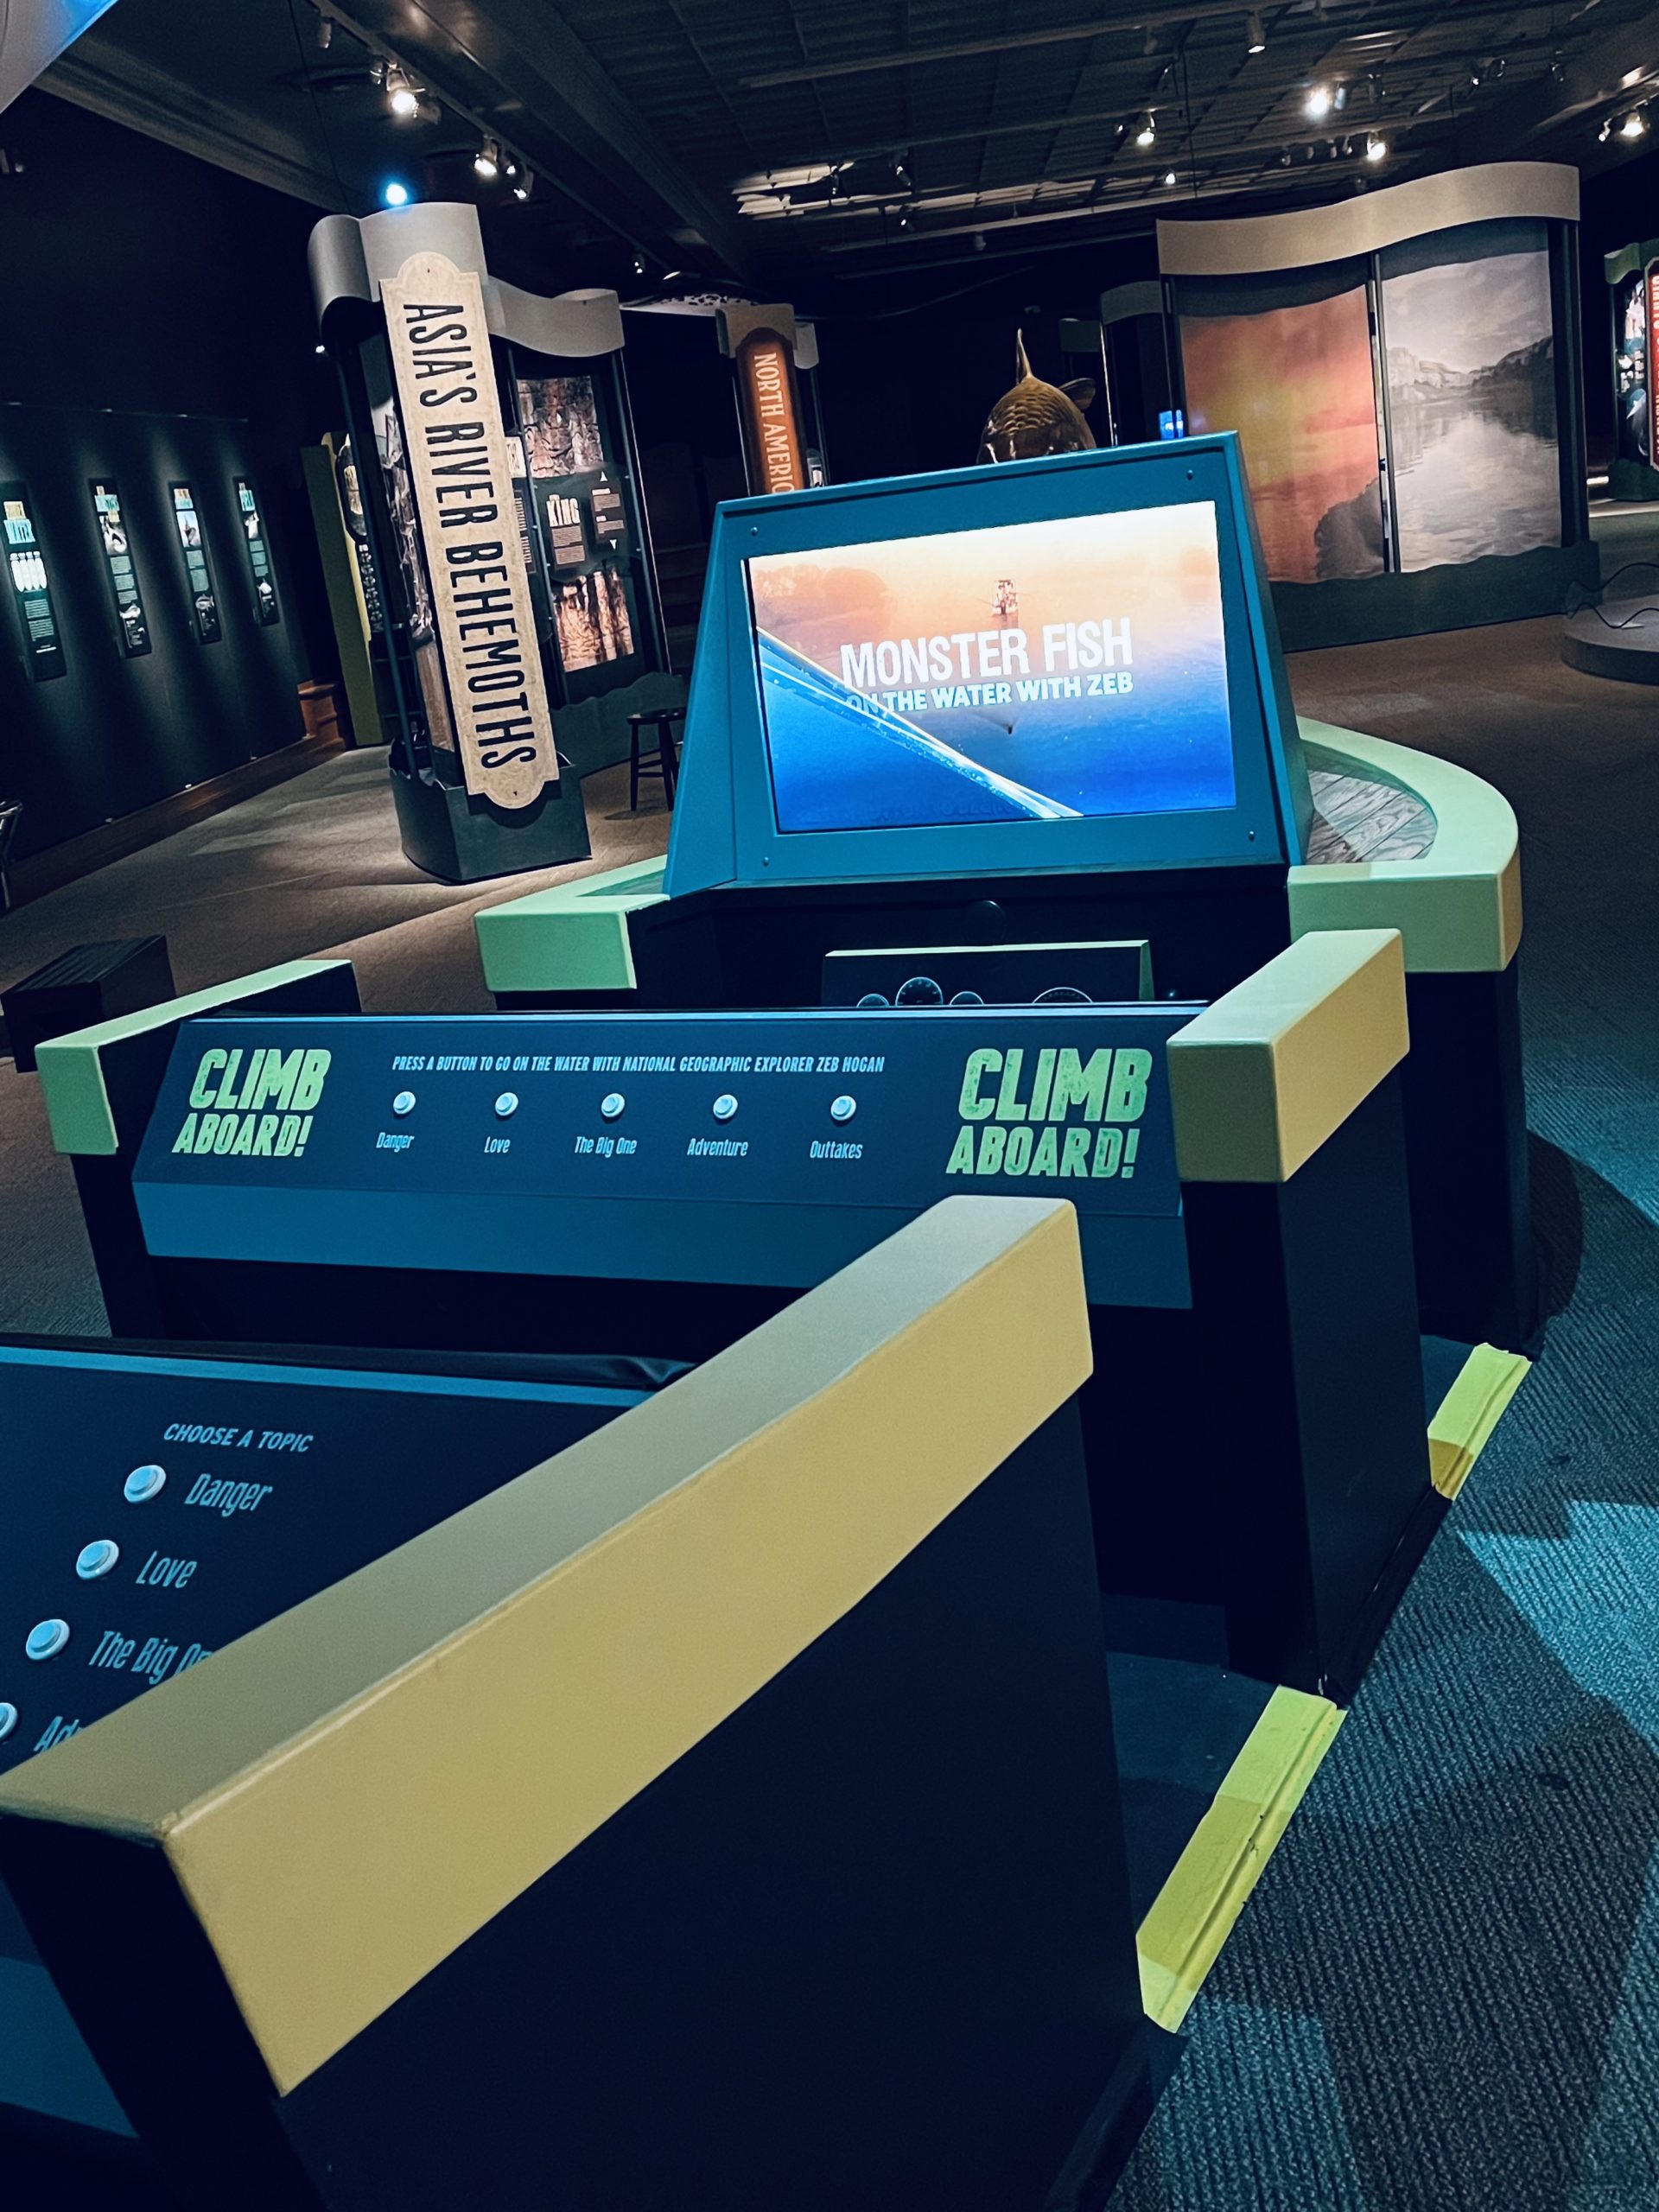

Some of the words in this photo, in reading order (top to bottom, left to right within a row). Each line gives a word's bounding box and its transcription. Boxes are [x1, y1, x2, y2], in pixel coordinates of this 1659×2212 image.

[404, 304, 478, 408] ASIA'S
[753, 353, 785, 418] NORTH
[425, 422, 499, 529] RIVER
[446, 541, 537, 769] BEHEMOTHS
[840, 628, 1031, 688] MONSTER
[1042, 617, 1134, 671] FISH
[883, 689, 928, 713] THE
[930, 682, 1013, 709] WATER
[1015, 675, 1082, 702] WITH
[1085, 671, 1135, 696] ZEB
[188, 1048, 332, 1111] CLIMB
[391, 1055, 425, 1071] PRESS
[425, 1055, 435, 1071] A
[435, 1055, 478, 1071] BUTTON
[480, 1055, 493, 1071] TO
[495, 1055, 511, 1071] GO
[512, 1055, 530, 1071] ON
[531, 1055, 552, 1071] THE
[554, 1055, 591, 1071] WATER
[592, 1055, 621, 1071] WITH
[622, 1055, 676, 1072] NATIONAL
[679, 1056, 753, 1072] GEOGRAPHIC
[753, 1056, 815, 1072] EXPLORER
[816, 1056, 840, 1072] ZEB
[842, 1056, 886, 1072] HOGAN
[957, 1048, 1154, 1122] CLIMB
[172, 1112, 313, 1158] ABOARD!
[376, 1131, 415, 1153] Danger
[483, 1135, 511, 1154] Love
[574, 1136, 594, 1154] The
[594, 1136, 615, 1158] Big
[615, 1137, 638, 1154] One
[687, 1137, 749, 1157] Adventure
[809, 1140, 864, 1160] Outtakes
[945, 1124, 1141, 1179] ABOARD!
[163, 1422, 238, 1446] CHOOSE
[236, 1428, 254, 1447] A
[257, 1430, 315, 1453] TOPIC
[183, 1472, 274, 1517] Danger
[135, 1549, 198, 1589] Love
[87, 1630, 137, 1670] The
[130, 1637, 180, 1685] Big
